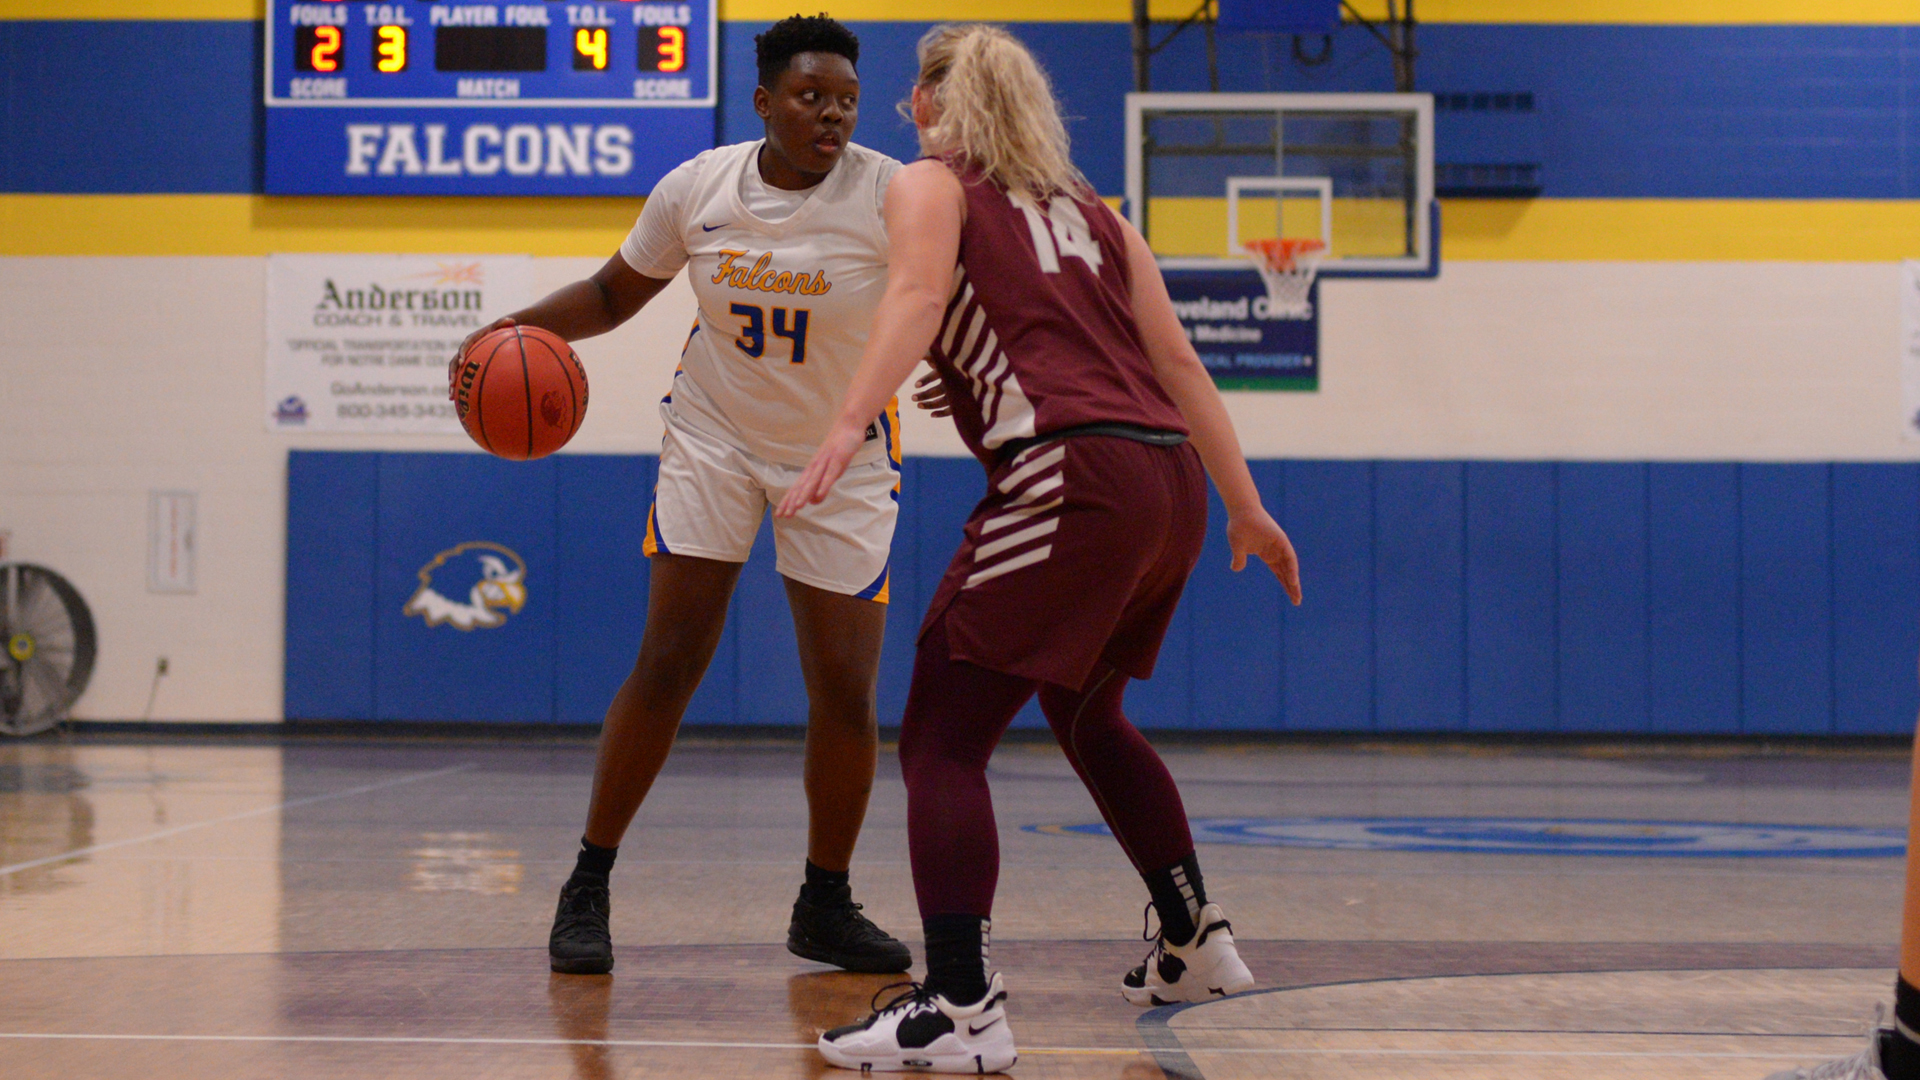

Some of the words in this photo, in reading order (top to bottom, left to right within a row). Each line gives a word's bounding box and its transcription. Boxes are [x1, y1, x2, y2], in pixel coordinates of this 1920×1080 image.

[290, 4, 347, 26] FOULS
[364, 5, 414, 26] T.O.L.
[430, 5, 498, 26] PLAYER
[505, 5, 551, 26] FOUL
[567, 5, 615, 26] T.O.L.
[633, 5, 691, 26] FOULS
[311, 25, 341, 71] 2
[378, 25, 405, 72] 3
[576, 28, 607, 69] 4
[658, 26, 684, 72] 3
[290, 78, 347, 98] SCORE
[457, 78, 520, 98] MATCH
[634, 78, 691, 98] SCORE
[346, 124, 633, 175] FALCONS
[1006, 189, 1103, 277] 14
[711, 248, 832, 296] Falcons
[316, 278, 483, 311] Anderson
[313, 313, 382, 327] COACH
[389, 313, 402, 327] &
[412, 313, 482, 327] TRAVEL
[729, 301, 811, 365] 34
[1195, 325, 1262, 342] Medicine
[331, 381, 450, 396] GoAnderson.co
[458, 361, 482, 436] Wils
